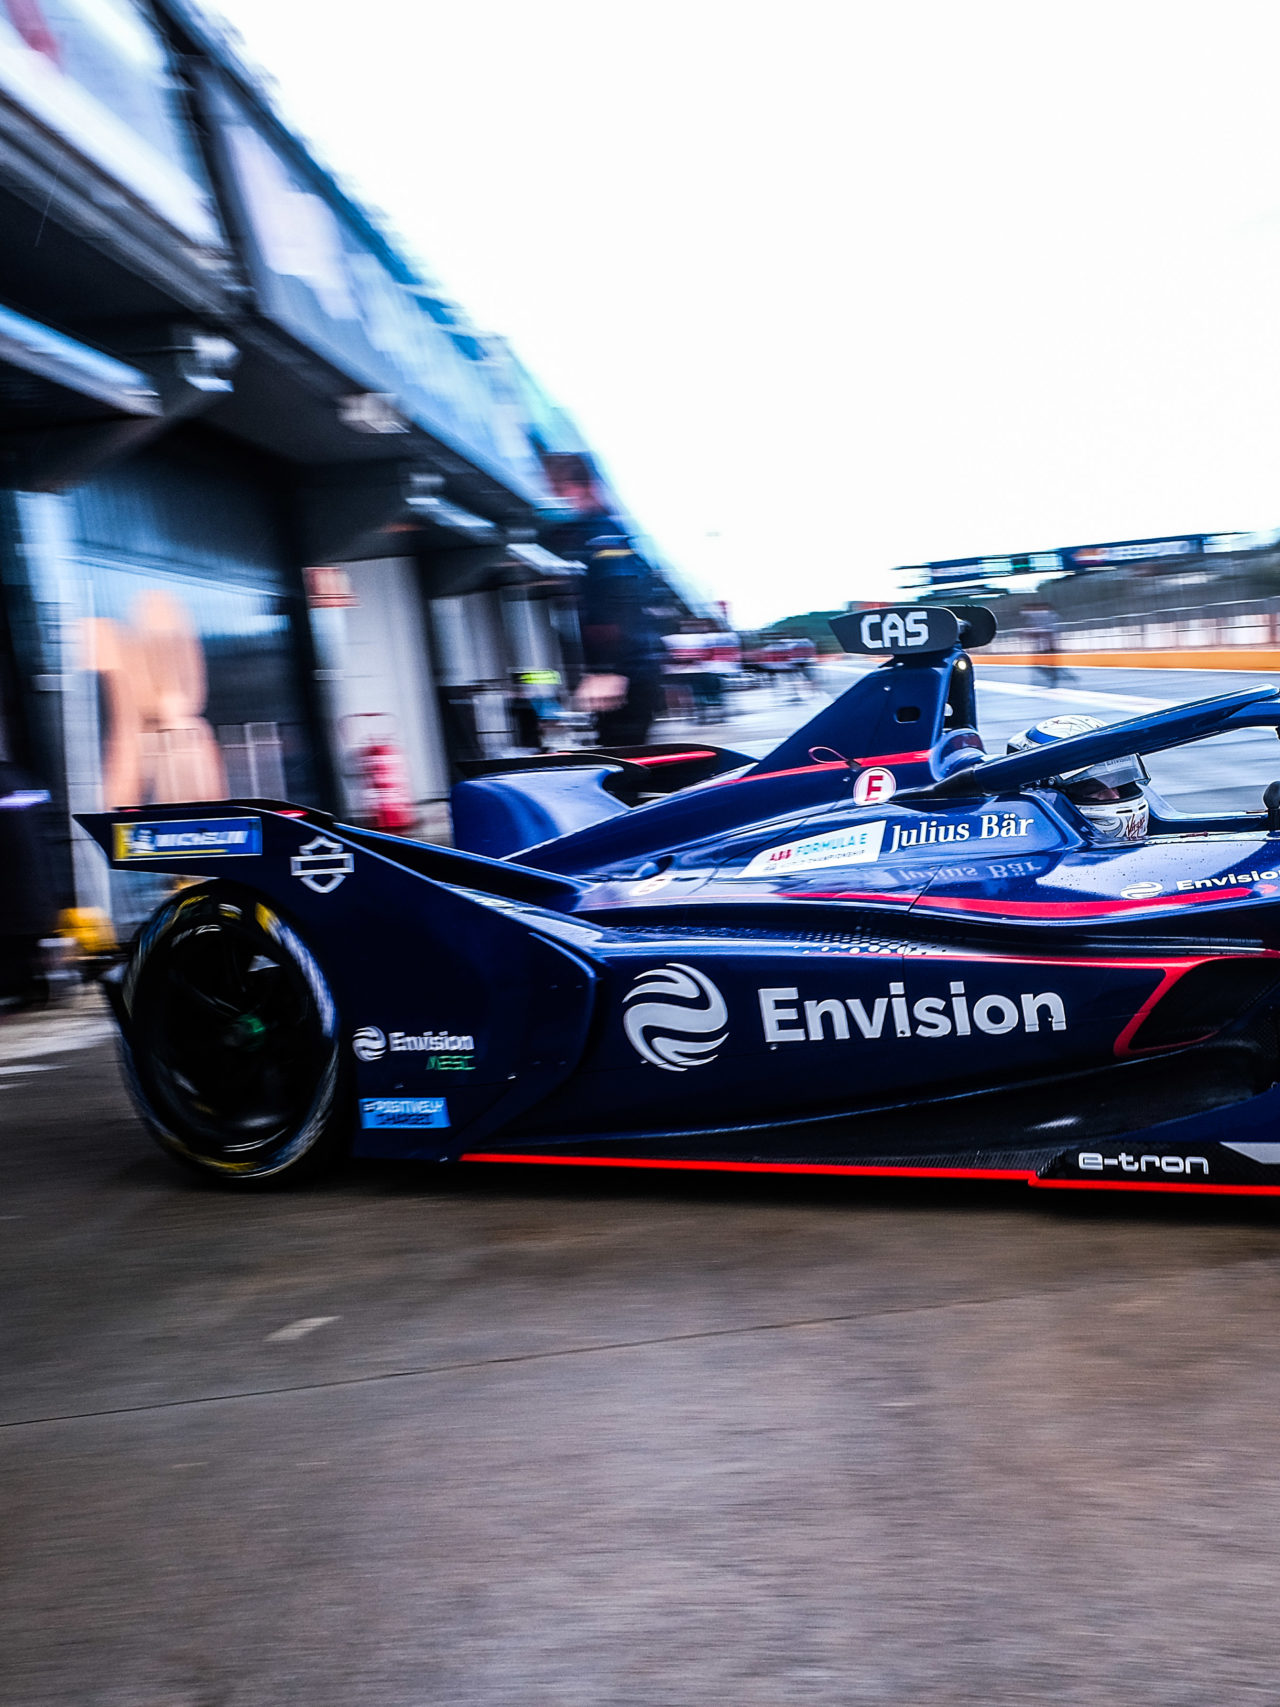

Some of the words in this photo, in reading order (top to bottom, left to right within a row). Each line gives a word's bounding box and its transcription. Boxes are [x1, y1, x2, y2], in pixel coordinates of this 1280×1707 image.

[860, 611, 929, 649] CAS
[864, 775, 884, 802] E
[796, 835, 856, 856] FORMULA
[889, 818, 971, 853] Julius
[979, 812, 1035, 839] Bär
[757, 979, 1068, 1044] Envision
[388, 1030, 475, 1052] Envision
[1078, 1152, 1210, 1175] e-tron
